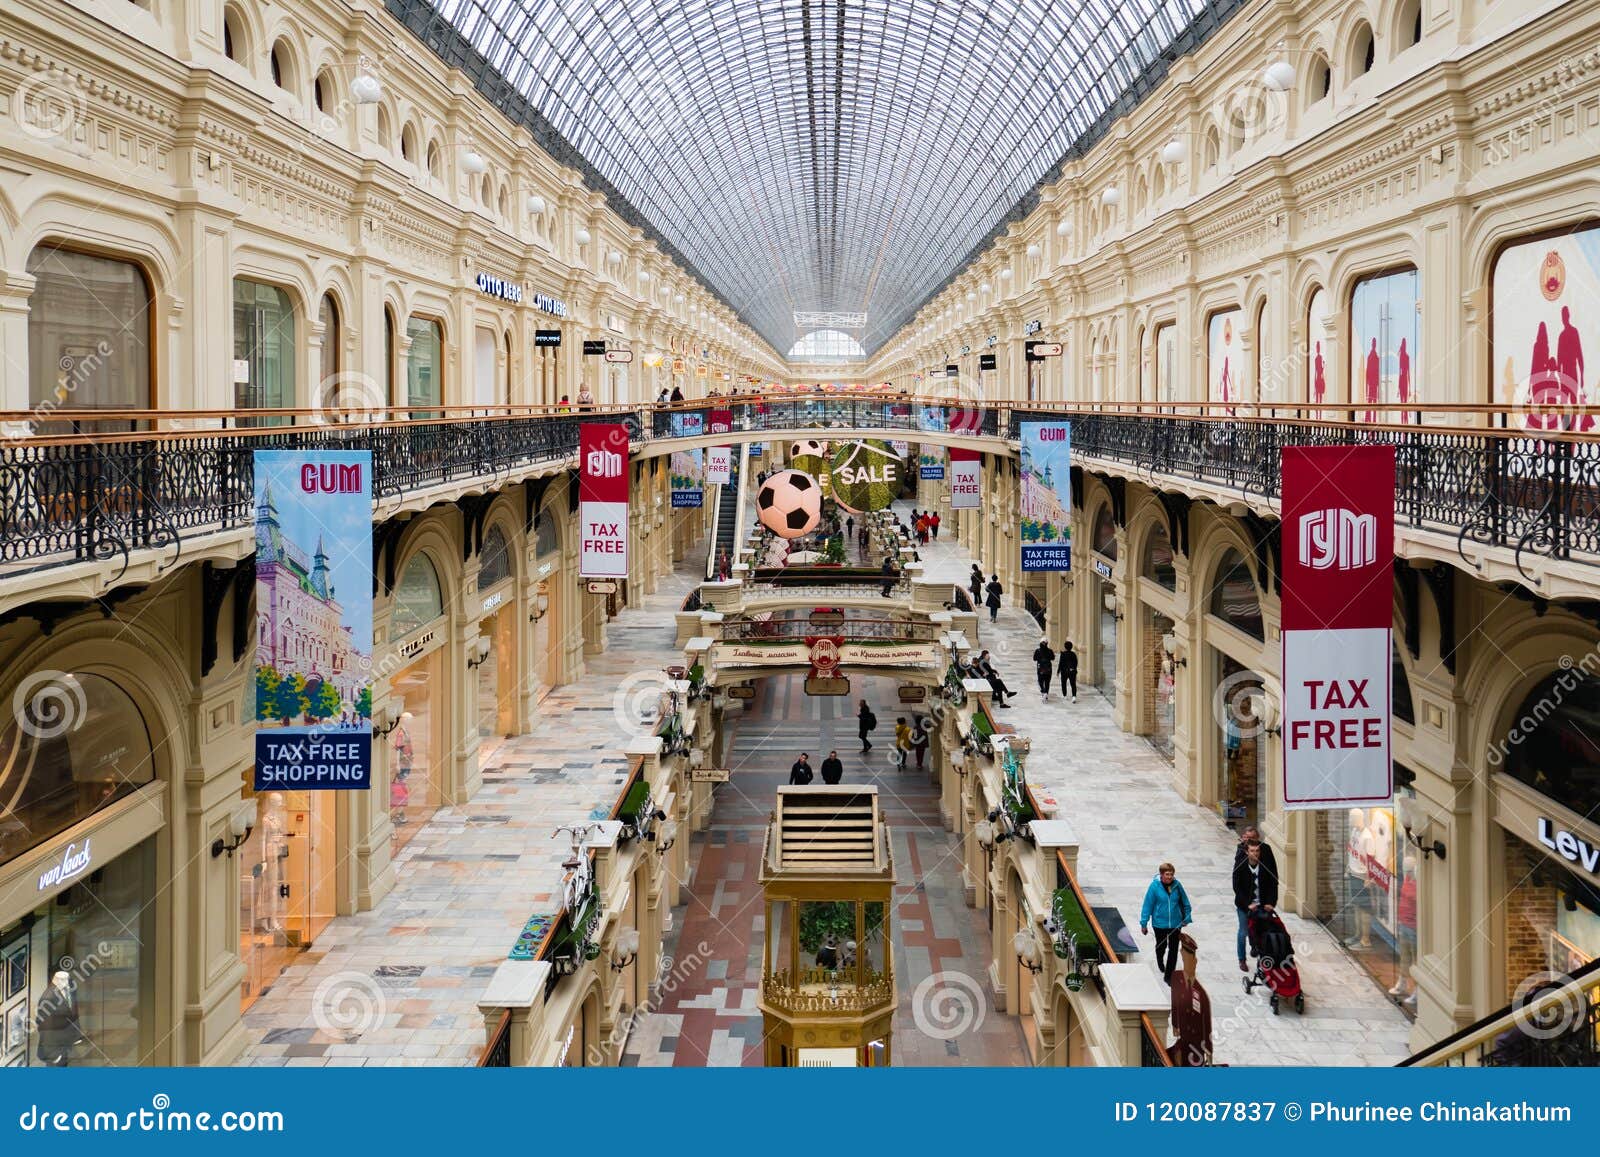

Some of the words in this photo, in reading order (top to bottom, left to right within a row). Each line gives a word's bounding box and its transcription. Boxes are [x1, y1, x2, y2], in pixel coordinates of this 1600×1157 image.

[479, 273, 502, 296] OTTO
[503, 283, 522, 302] BERG
[537, 294, 553, 312] OTTO
[1039, 428, 1066, 441] GUM
[708, 464, 728, 472] FREE
[841, 464, 897, 485] SALE
[300, 463, 363, 494] GUM
[956, 474, 975, 483] TAX
[953, 484, 979, 493] FREE
[590, 523, 619, 537] TAX
[584, 540, 625, 554] FREE
[1026, 550, 1042, 558] TAX
[1044, 550, 1066, 558] FREE
[1024, 559, 1068, 568] SHOPPING
[1303, 679, 1370, 710] TAX
[1291, 718, 1382, 750] FREE
[267, 744, 304, 761] TAX
[309, 743, 360, 760] FREE
[262, 764, 364, 781] SHOPPING
